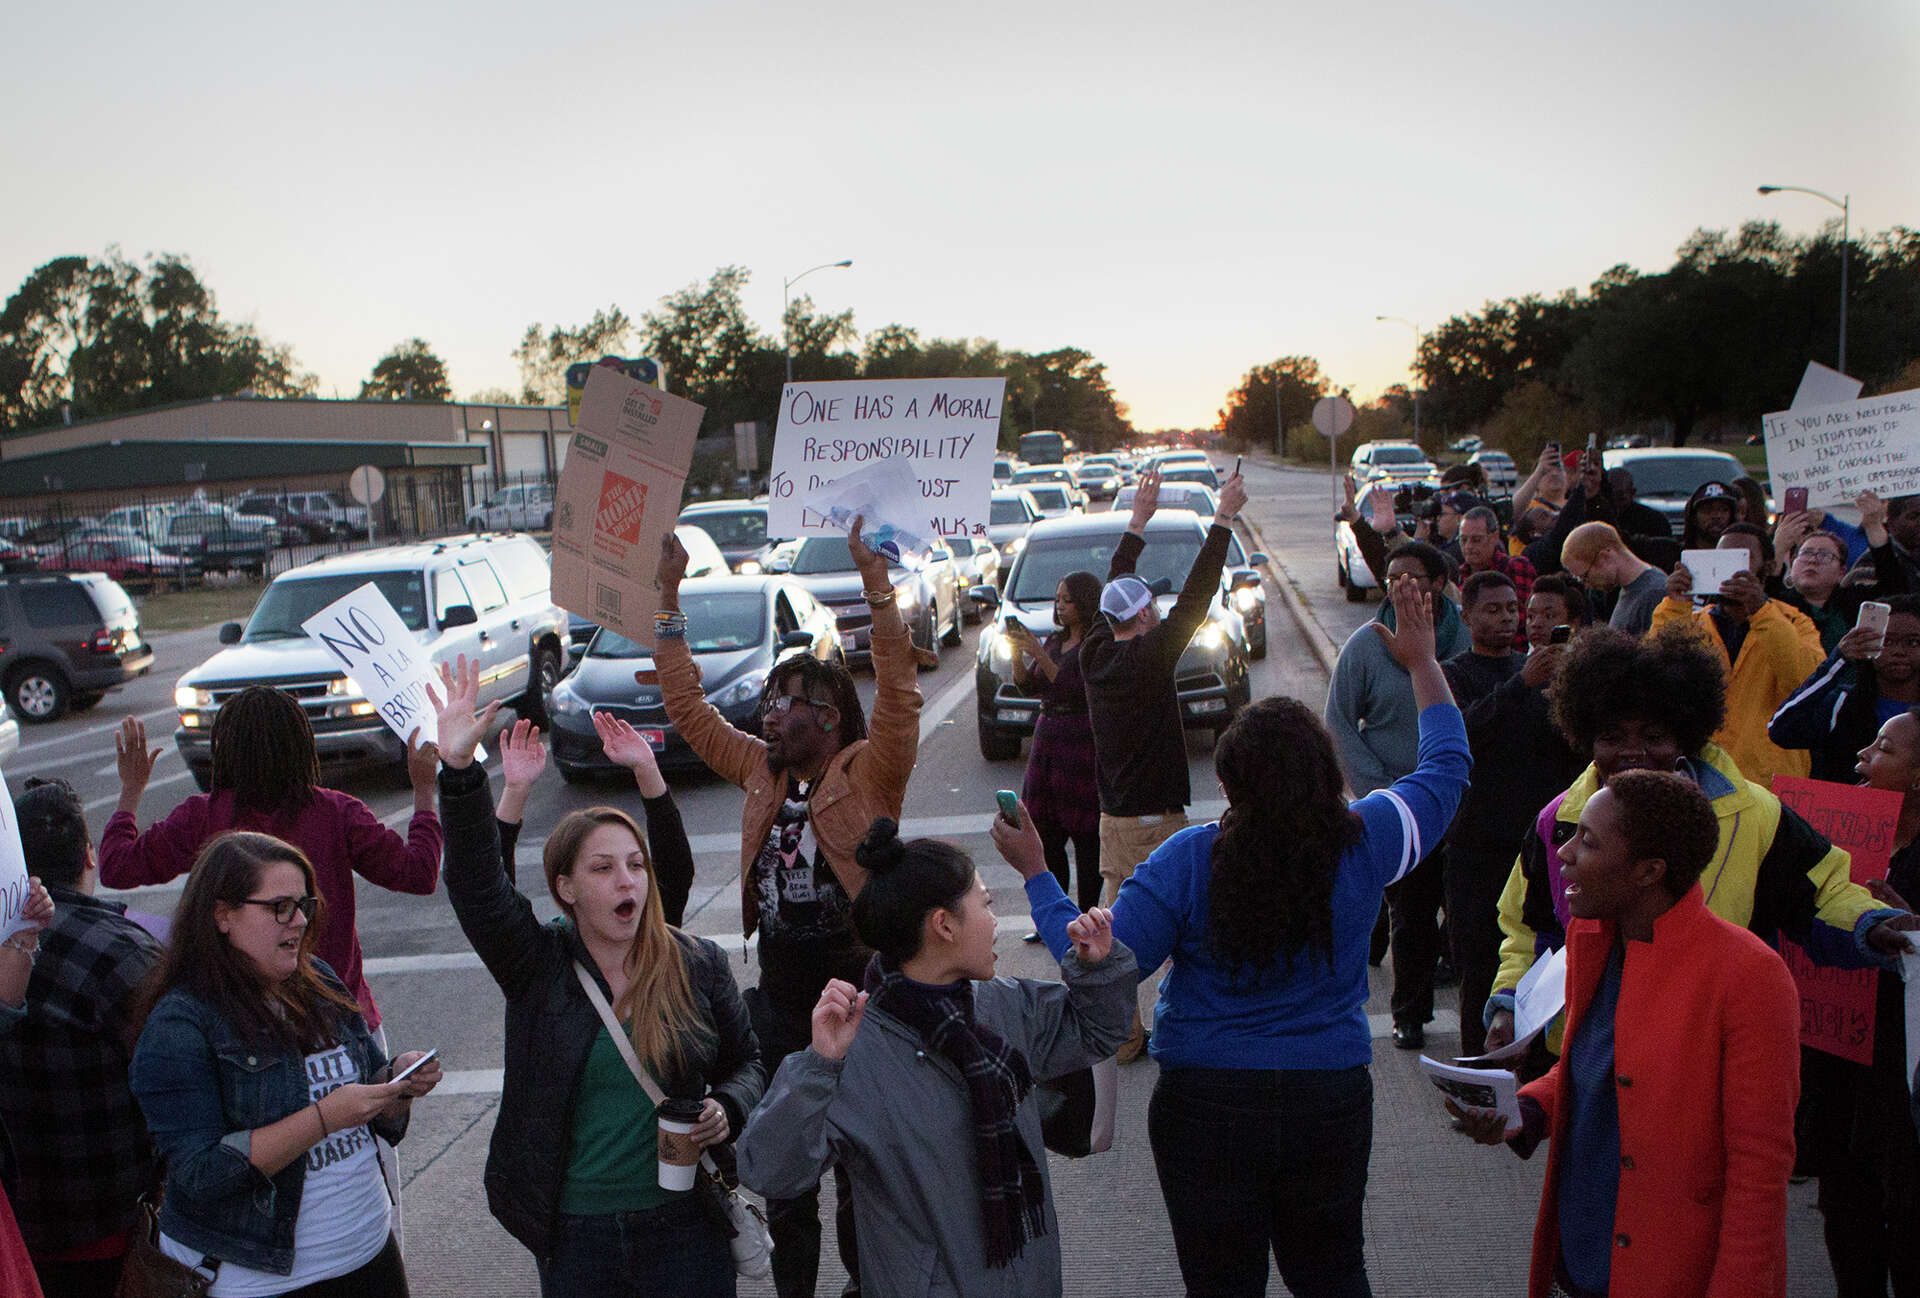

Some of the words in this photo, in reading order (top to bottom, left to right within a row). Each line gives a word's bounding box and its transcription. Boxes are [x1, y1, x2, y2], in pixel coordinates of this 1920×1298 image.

[854, 394, 894, 420] HAS
[905, 398, 918, 419] A
[928, 392, 1000, 419] MORAL
[1796, 416, 1821, 431] YOU
[1826, 412, 1850, 425] ARE
[1857, 402, 1918, 420] NEUTRAL
[803, 433, 975, 463] RESPONSIBILITY
[1787, 438, 1806, 453] IN
[1883, 420, 1900, 432] OF
[1815, 440, 1886, 462] INJUSTICE
[772, 470, 794, 498] TO
[917, 478, 961, 498] UST
[1816, 480, 1834, 493] OF
[319, 606, 385, 669] NO
[372, 662, 396, 688] A
[388, 649, 413, 673] LA
[304, 1127, 370, 1171] UALITY
